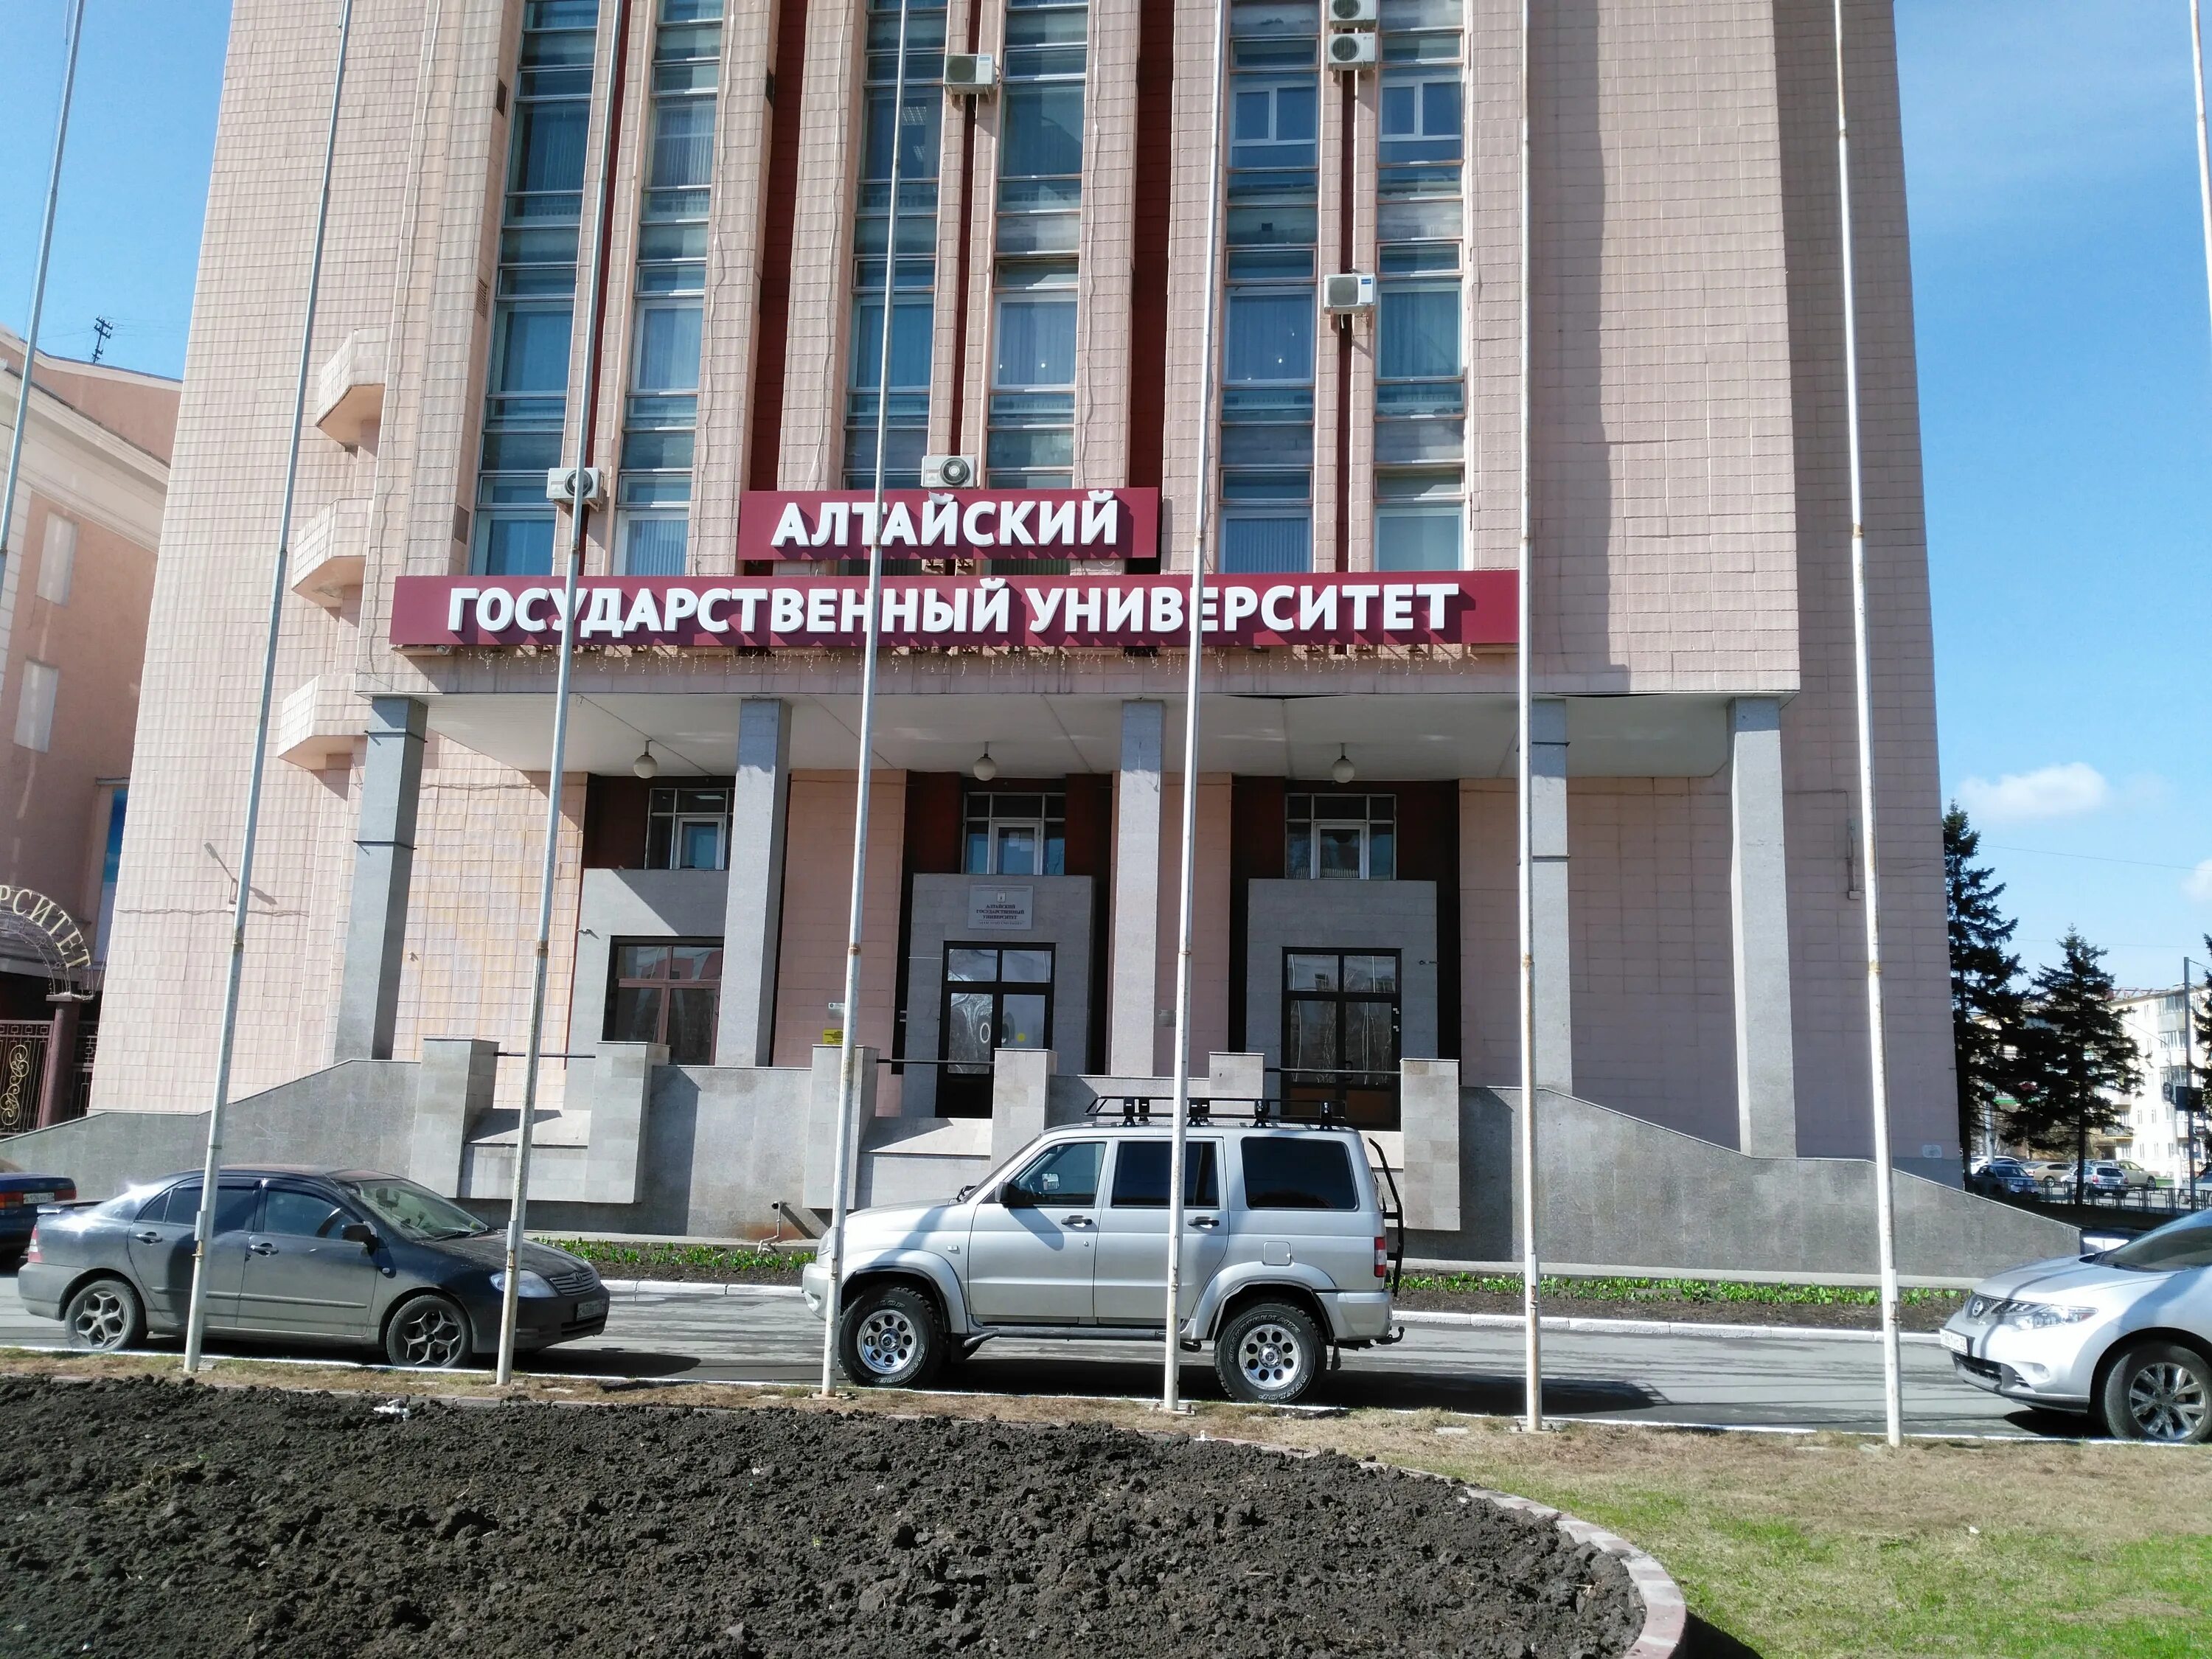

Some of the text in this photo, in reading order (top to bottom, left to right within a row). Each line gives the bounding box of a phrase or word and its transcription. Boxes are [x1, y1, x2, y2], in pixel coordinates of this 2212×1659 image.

[771, 490, 1118, 547] АЛТАЙСКИЙ
[447, 577, 1459, 639] ГОСУДАРСТВЕННЫЙ УНИВЕРСИТЕТ
[1228, 1315, 1277, 1363] GRANDTREK
[1258, 1373, 1308, 1400] DUNLOP
